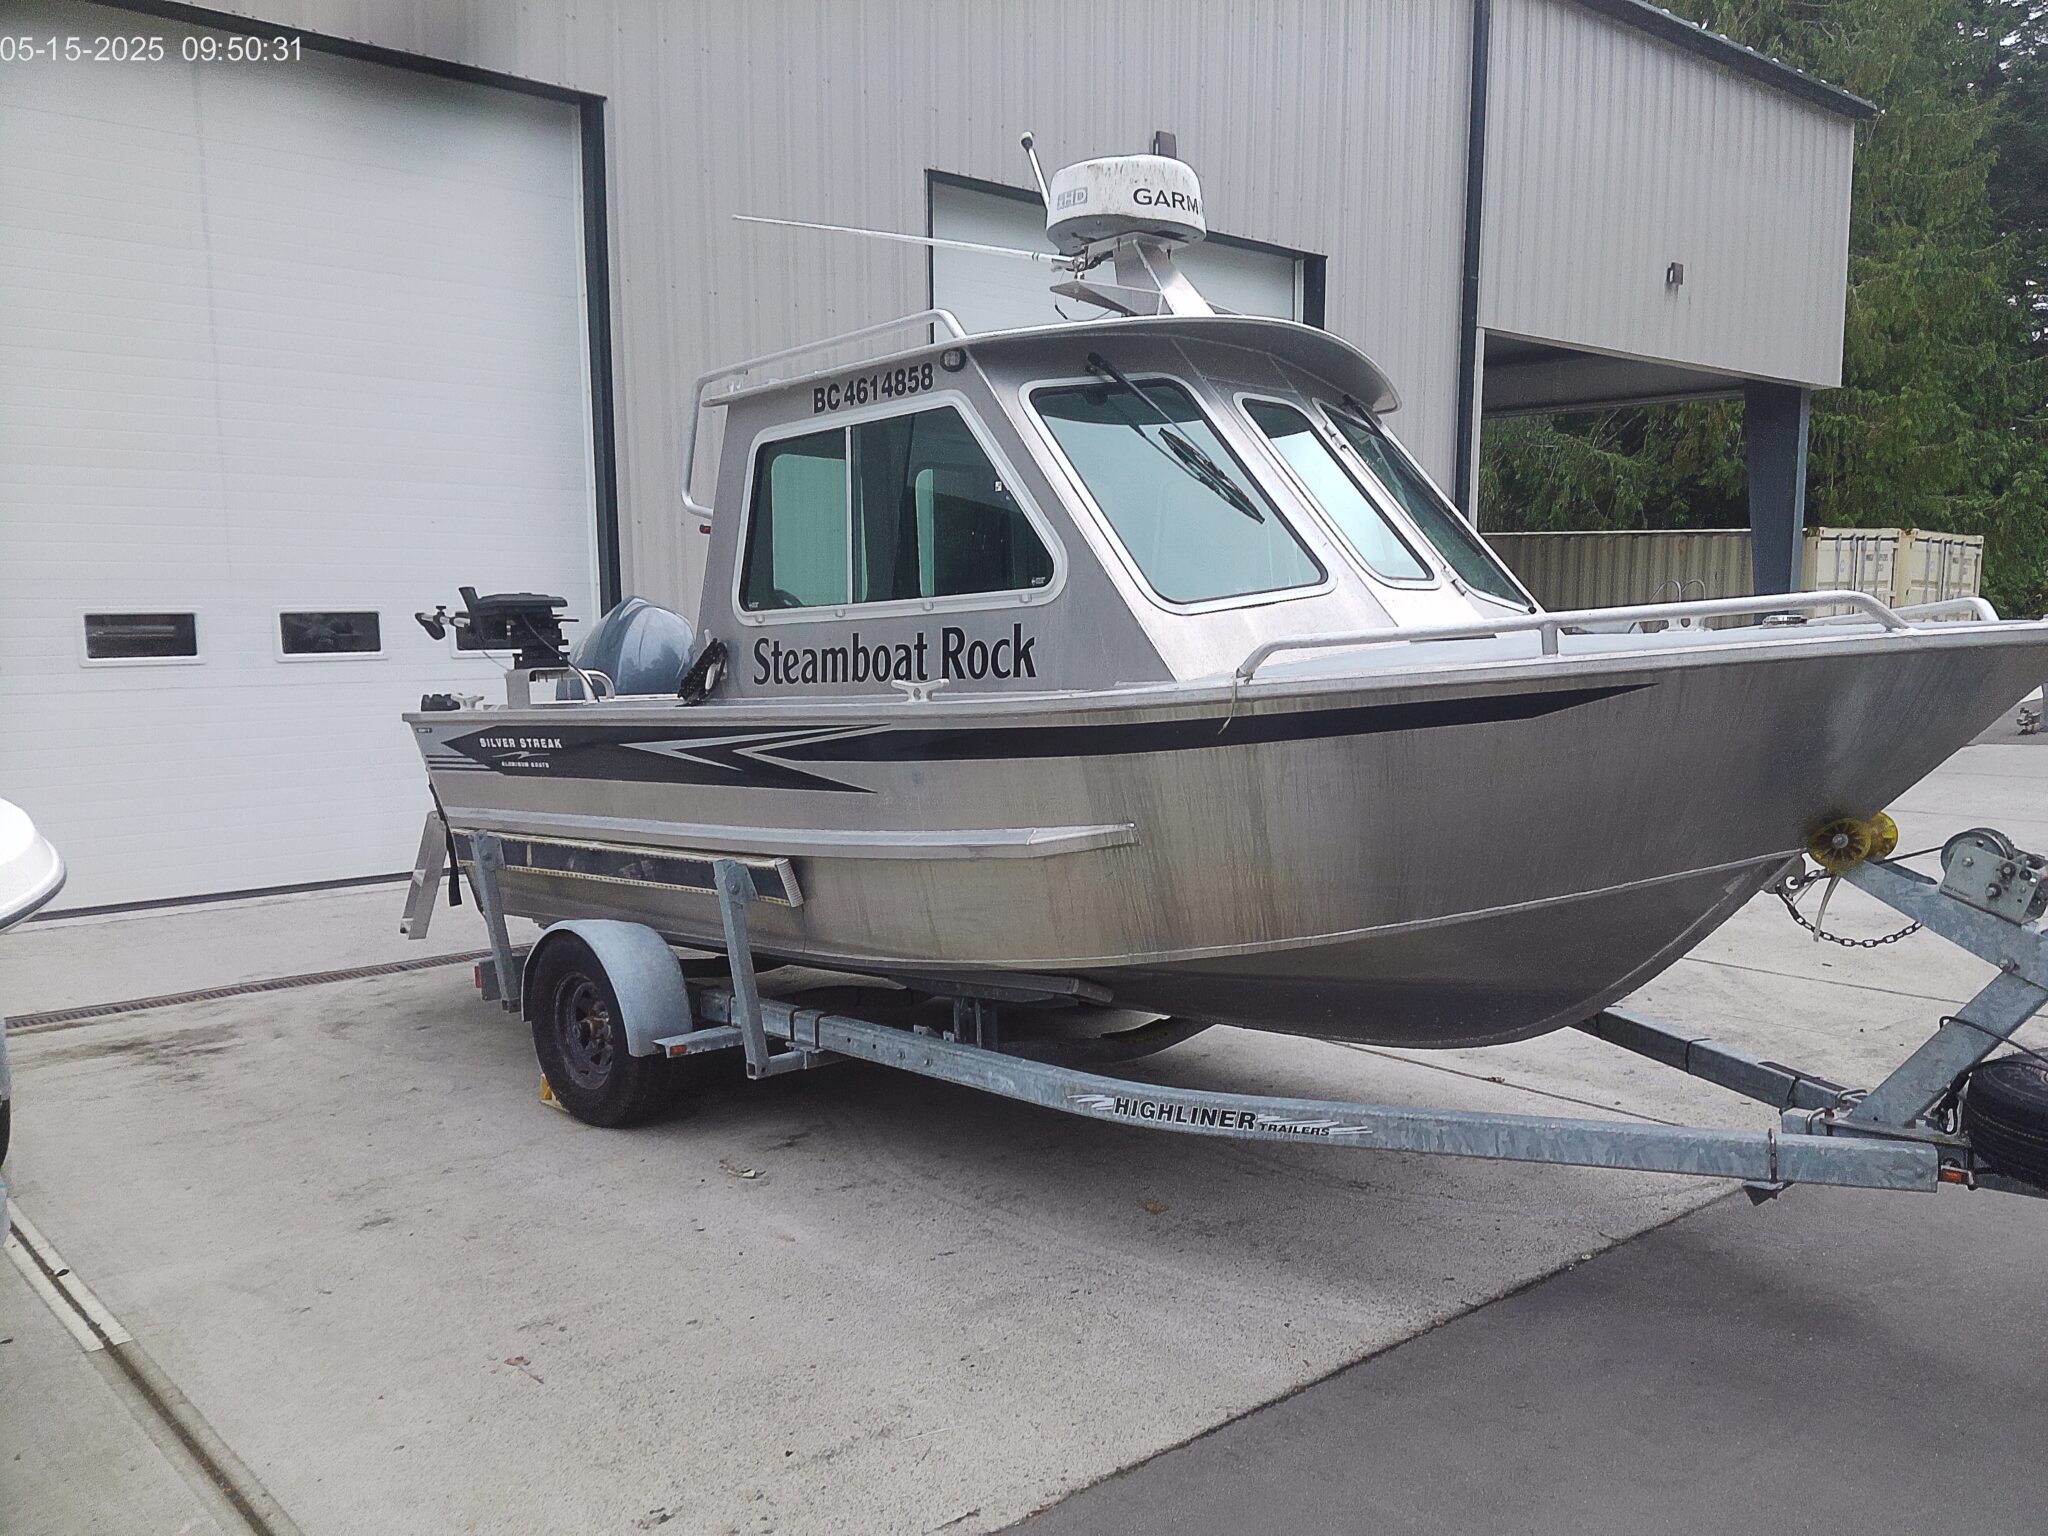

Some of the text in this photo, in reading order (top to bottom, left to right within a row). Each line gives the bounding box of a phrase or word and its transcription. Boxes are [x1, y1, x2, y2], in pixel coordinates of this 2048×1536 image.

[1133, 187, 1200, 215] GARM
[753, 622, 1037, 685] Steamboat Rock
[479, 738, 562, 749] SILVER STREAK
[1113, 1097, 1331, 1136] HIGHLINER TRAILERS
